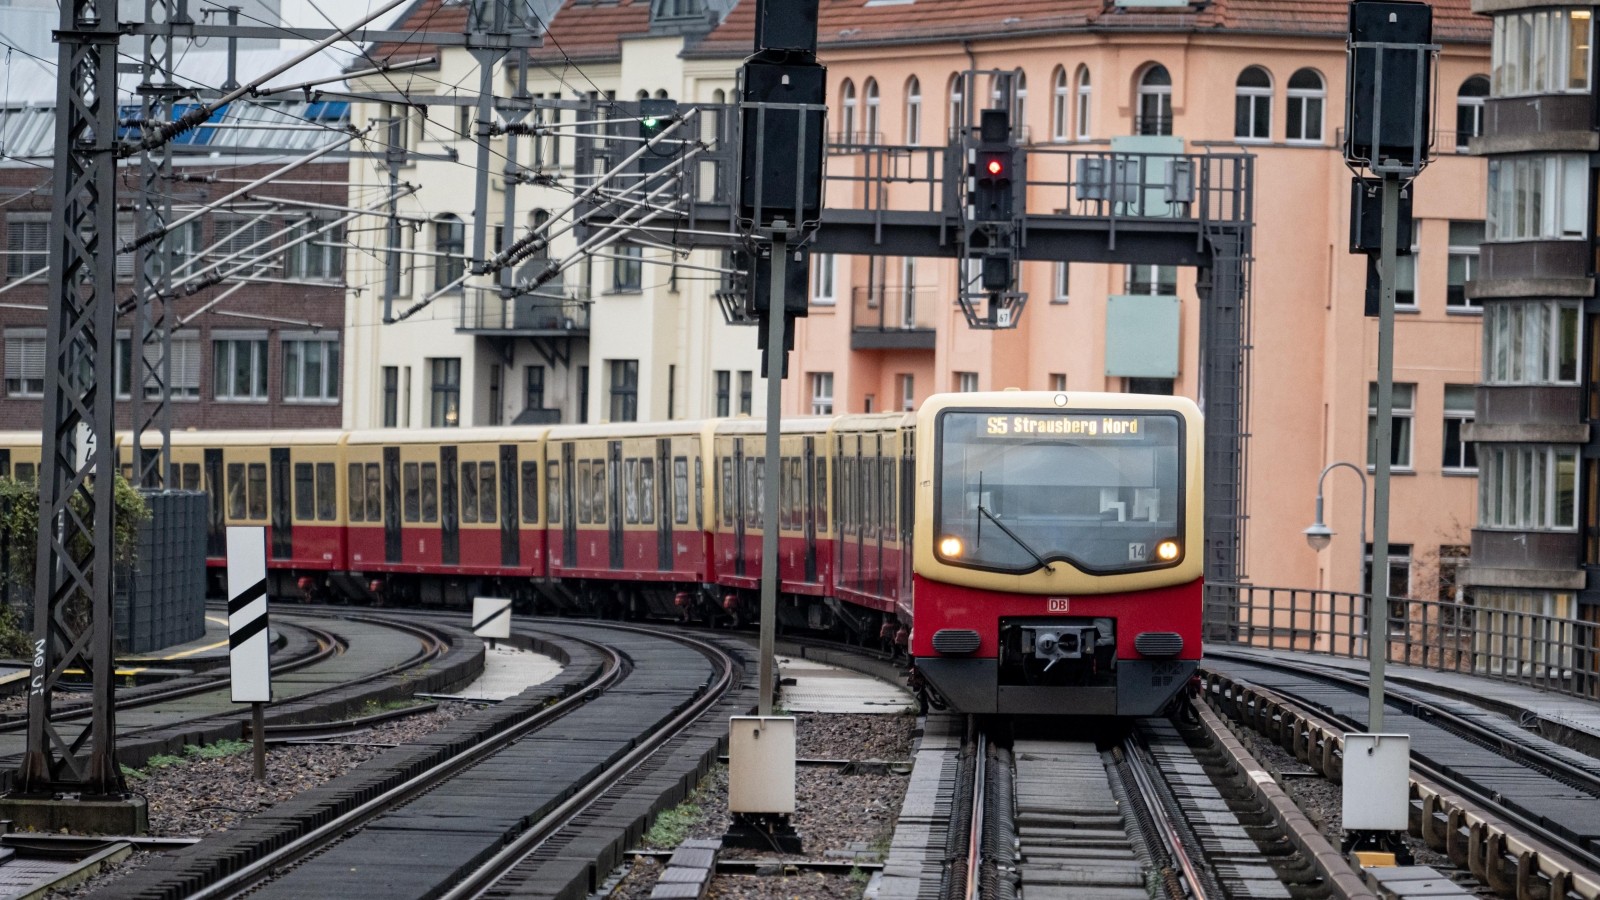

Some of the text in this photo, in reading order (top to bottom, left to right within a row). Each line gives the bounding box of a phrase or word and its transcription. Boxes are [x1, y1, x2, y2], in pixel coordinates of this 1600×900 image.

[998, 313, 1009, 323] 67
[987, 416, 1138, 435] S5 Strausberg Nord
[1130, 544, 1146, 559] 14
[1049, 599, 1068, 612] DB
